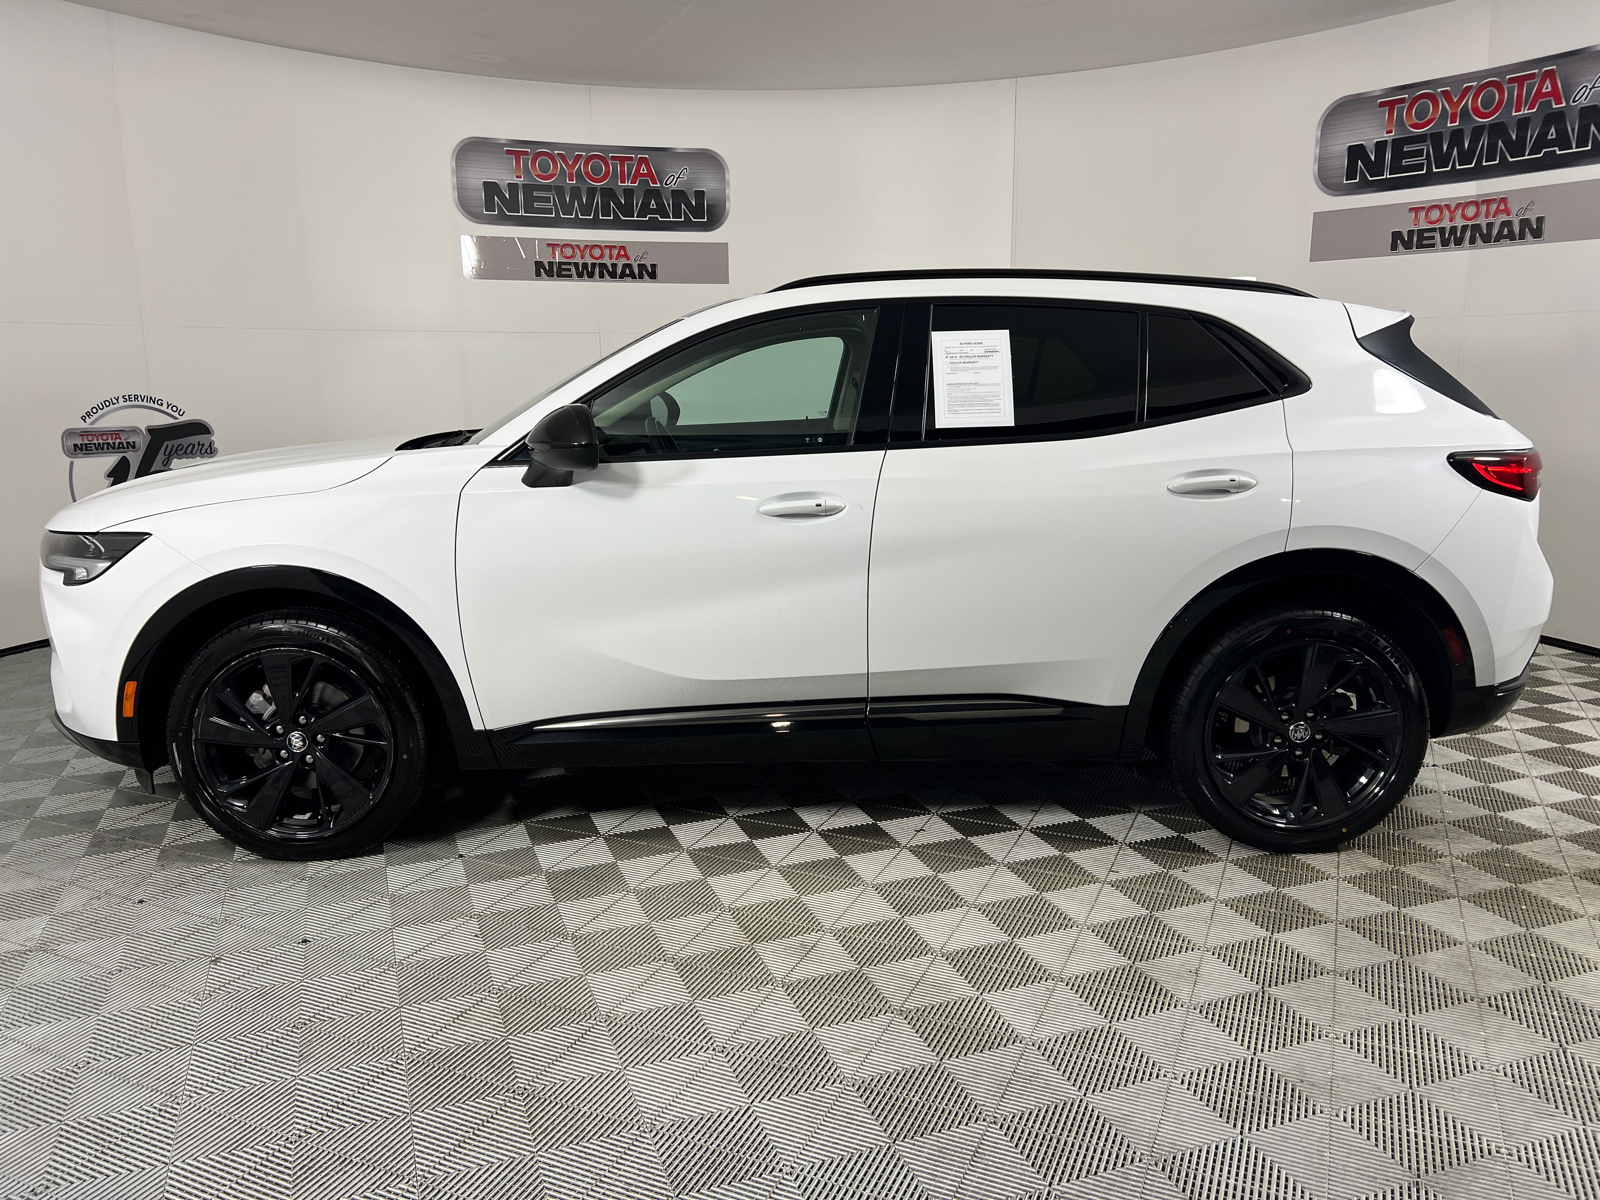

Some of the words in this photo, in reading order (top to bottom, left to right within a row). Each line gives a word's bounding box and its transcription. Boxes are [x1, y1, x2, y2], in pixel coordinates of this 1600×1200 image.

[1378, 66, 1566, 136] TOYOTA
[504, 148, 660, 187] TOYOTA
[662, 167, 688, 188] of
[482, 180, 707, 222] NEWNAN
[1408, 196, 1512, 227] TOYOTA
[1515, 200, 1535, 216] of
[1390, 214, 1546, 253] NEWNAN
[546, 242, 630, 261] TOYOTA
[634, 251, 648, 262] of
[534, 260, 658, 281] NEWNAN
[80, 396, 120, 423] PROUDLY
[122, 394, 163, 407] SERVING
[166, 402, 186, 417] YOU
[73, 441, 136, 452] NEWNAN
[79, 433, 122, 442] TOYOTA
[162, 440, 216, 467] years
